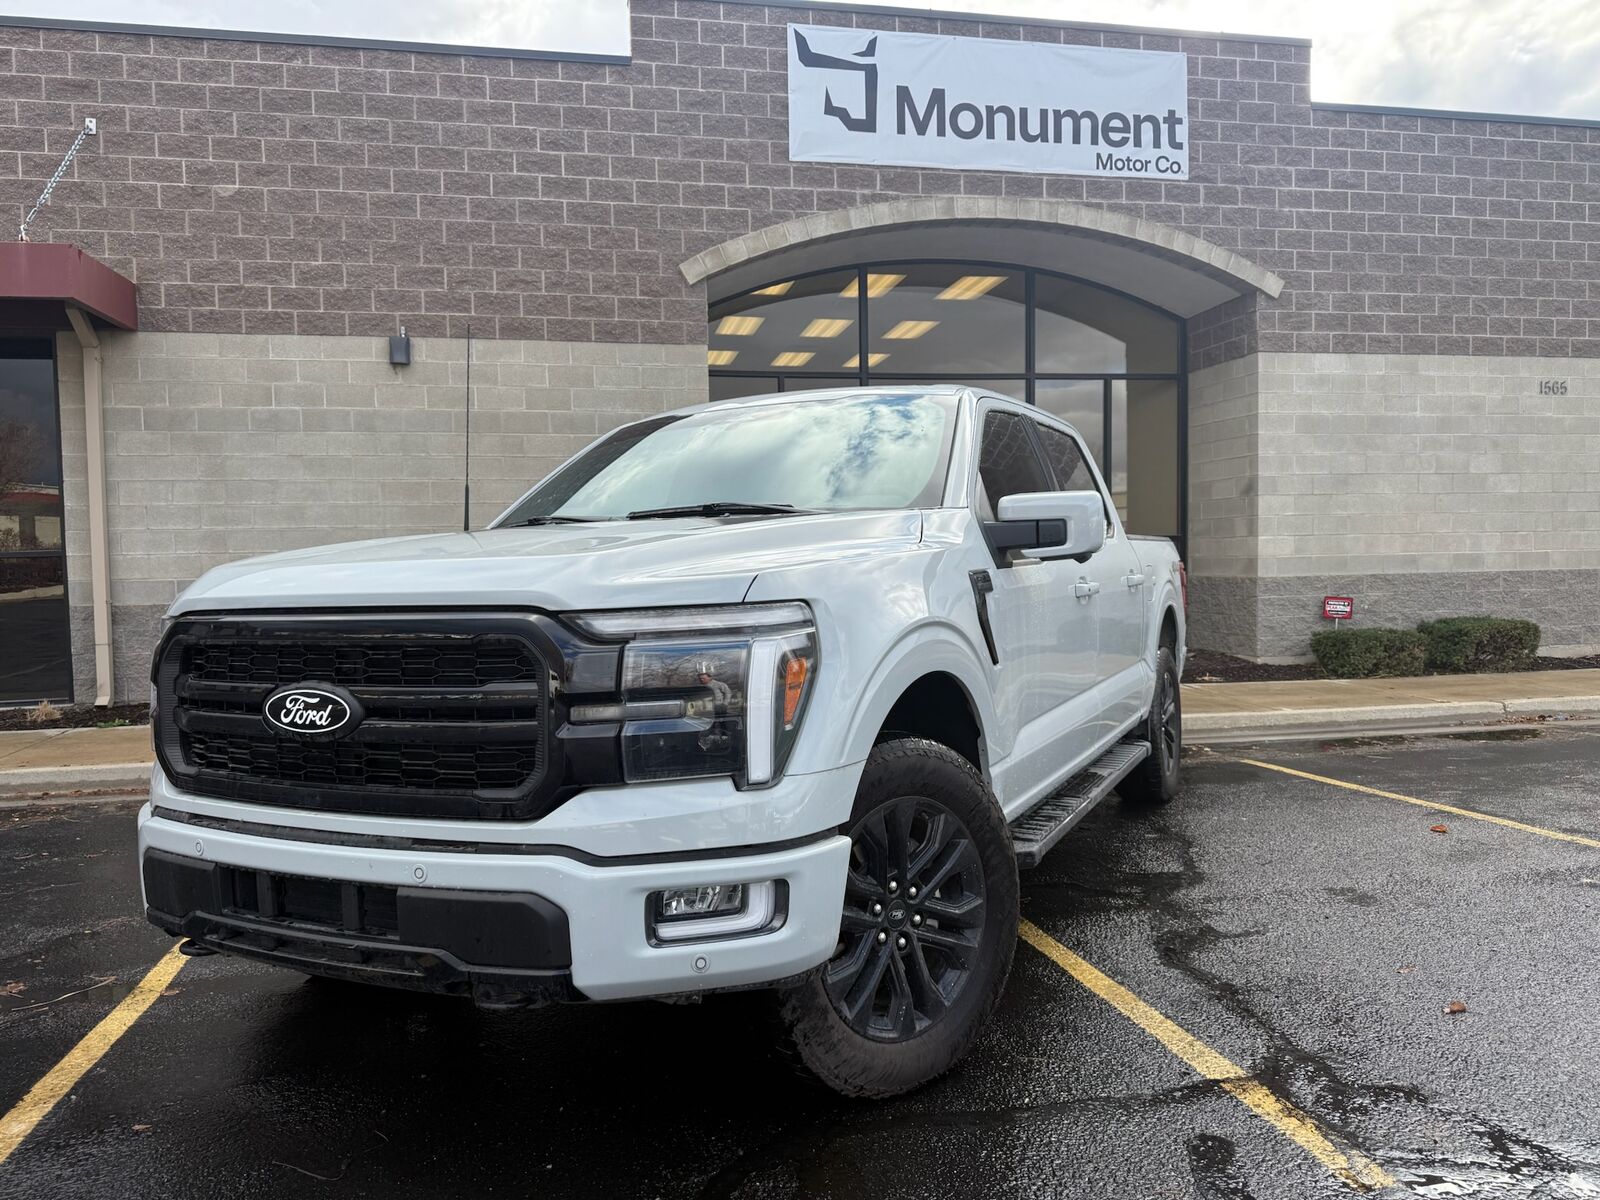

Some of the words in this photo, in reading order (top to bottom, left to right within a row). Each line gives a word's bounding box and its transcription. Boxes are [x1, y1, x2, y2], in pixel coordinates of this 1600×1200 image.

[896, 85, 1184, 150] Monument
[1096, 153, 1151, 172] Motor
[1539, 380, 1567, 395] 1565
[281, 695, 333, 726] Ford
